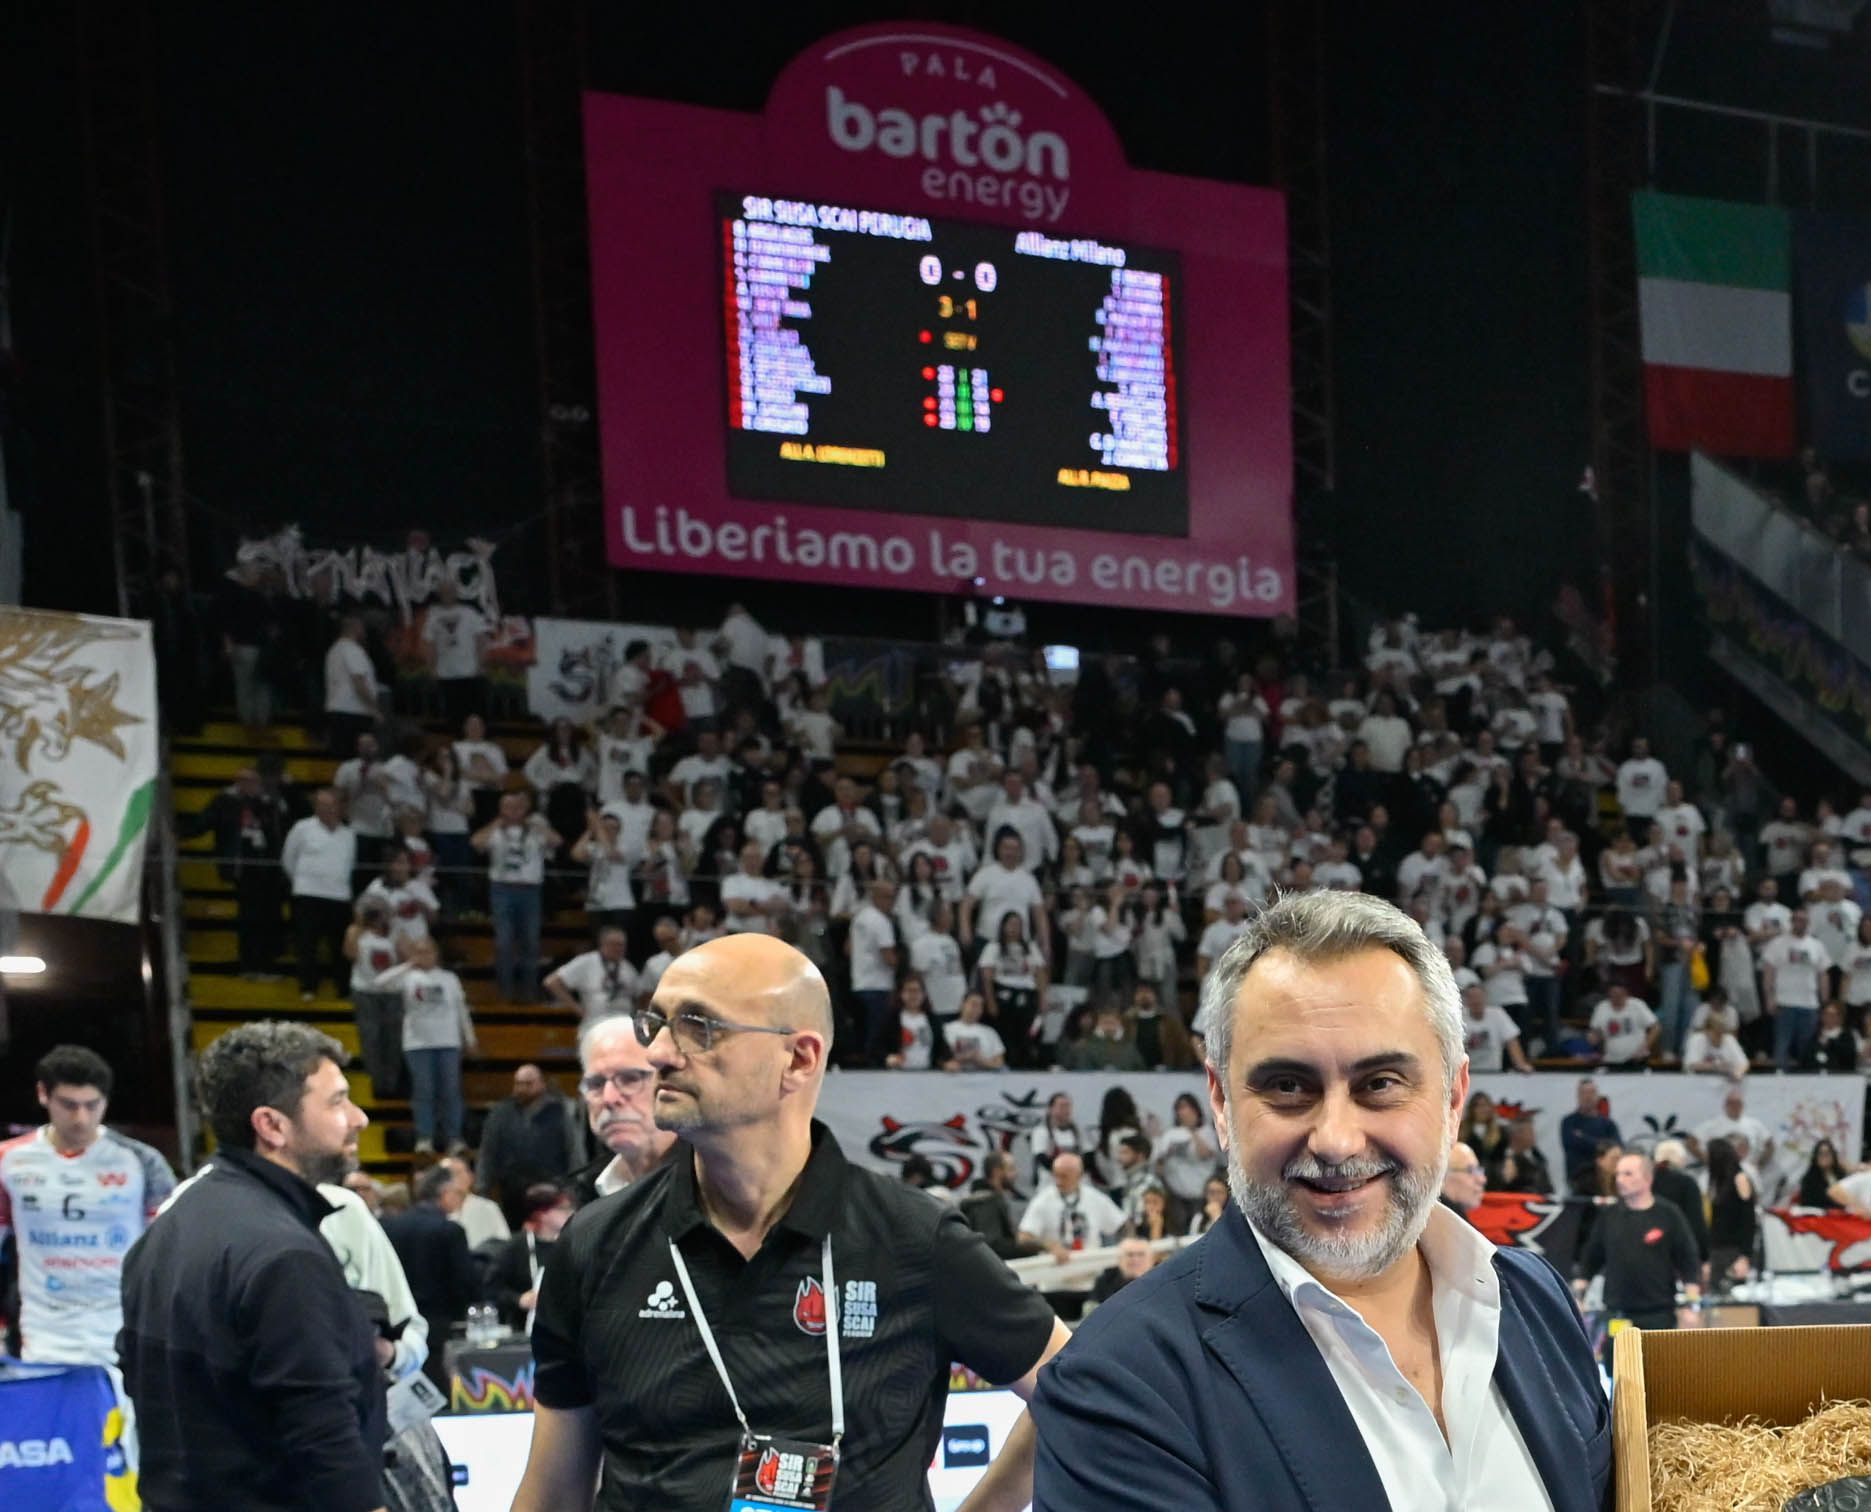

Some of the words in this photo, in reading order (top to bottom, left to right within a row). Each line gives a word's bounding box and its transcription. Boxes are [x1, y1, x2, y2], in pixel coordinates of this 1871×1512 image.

[900, 51, 998, 89] PALA
[921, 168, 1070, 221] energy
[919, 254, 942, 286] 0
[974, 262, 997, 292] 0
[622, 507, 915, 573] Liberiamo
[929, 528, 979, 579] la
[993, 540, 1077, 585] tua
[1091, 552, 1283, 607] energia
[62, 1194, 85, 1221] 6
[845, 1281, 876, 1300] SIR
[843, 1316, 874, 1331] SCAI
[844, 1301, 877, 1315] SUSA
